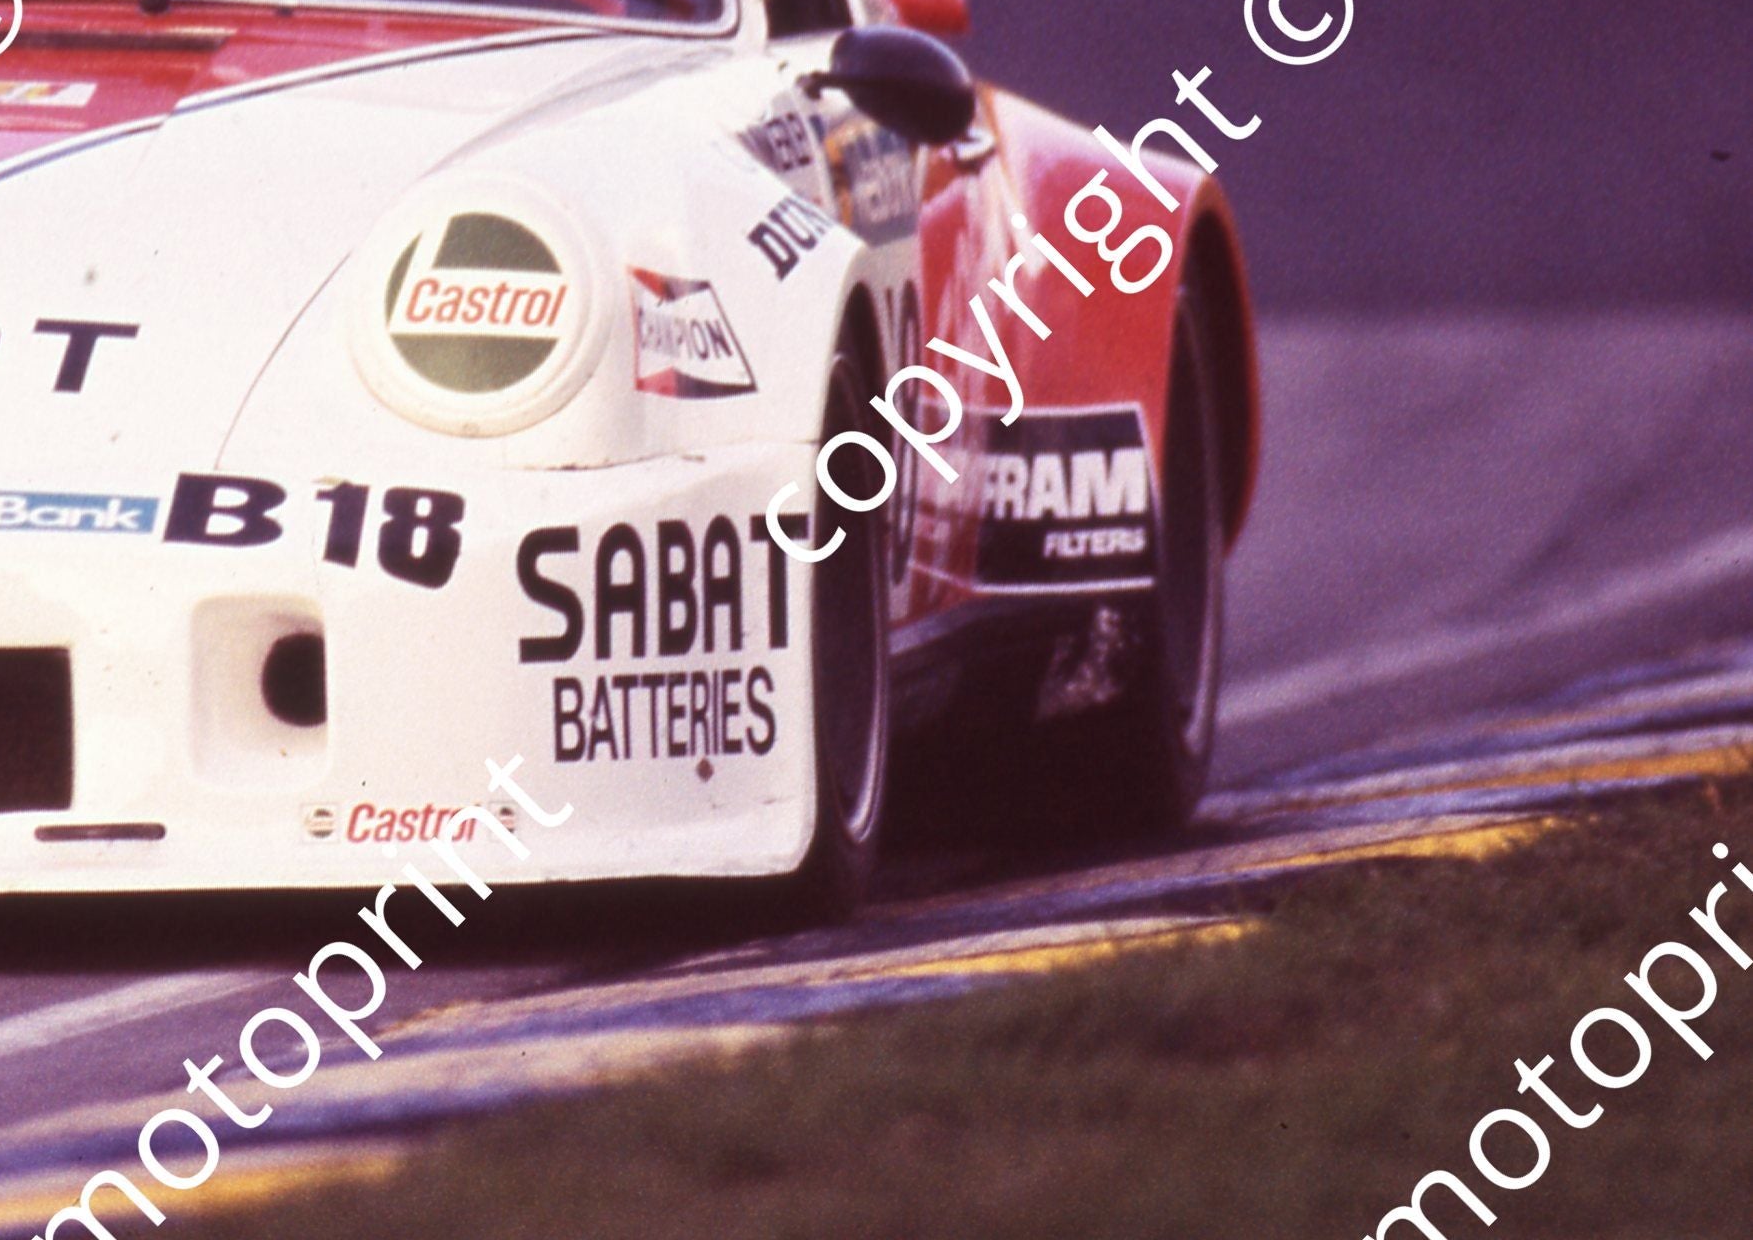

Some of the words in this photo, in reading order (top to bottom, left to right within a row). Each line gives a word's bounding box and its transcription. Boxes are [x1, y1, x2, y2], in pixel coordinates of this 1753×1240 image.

[405, 277, 568, 328] Castrol
[516, 513, 809, 663] SABAT
[553, 665, 777, 762] BATTERIES
